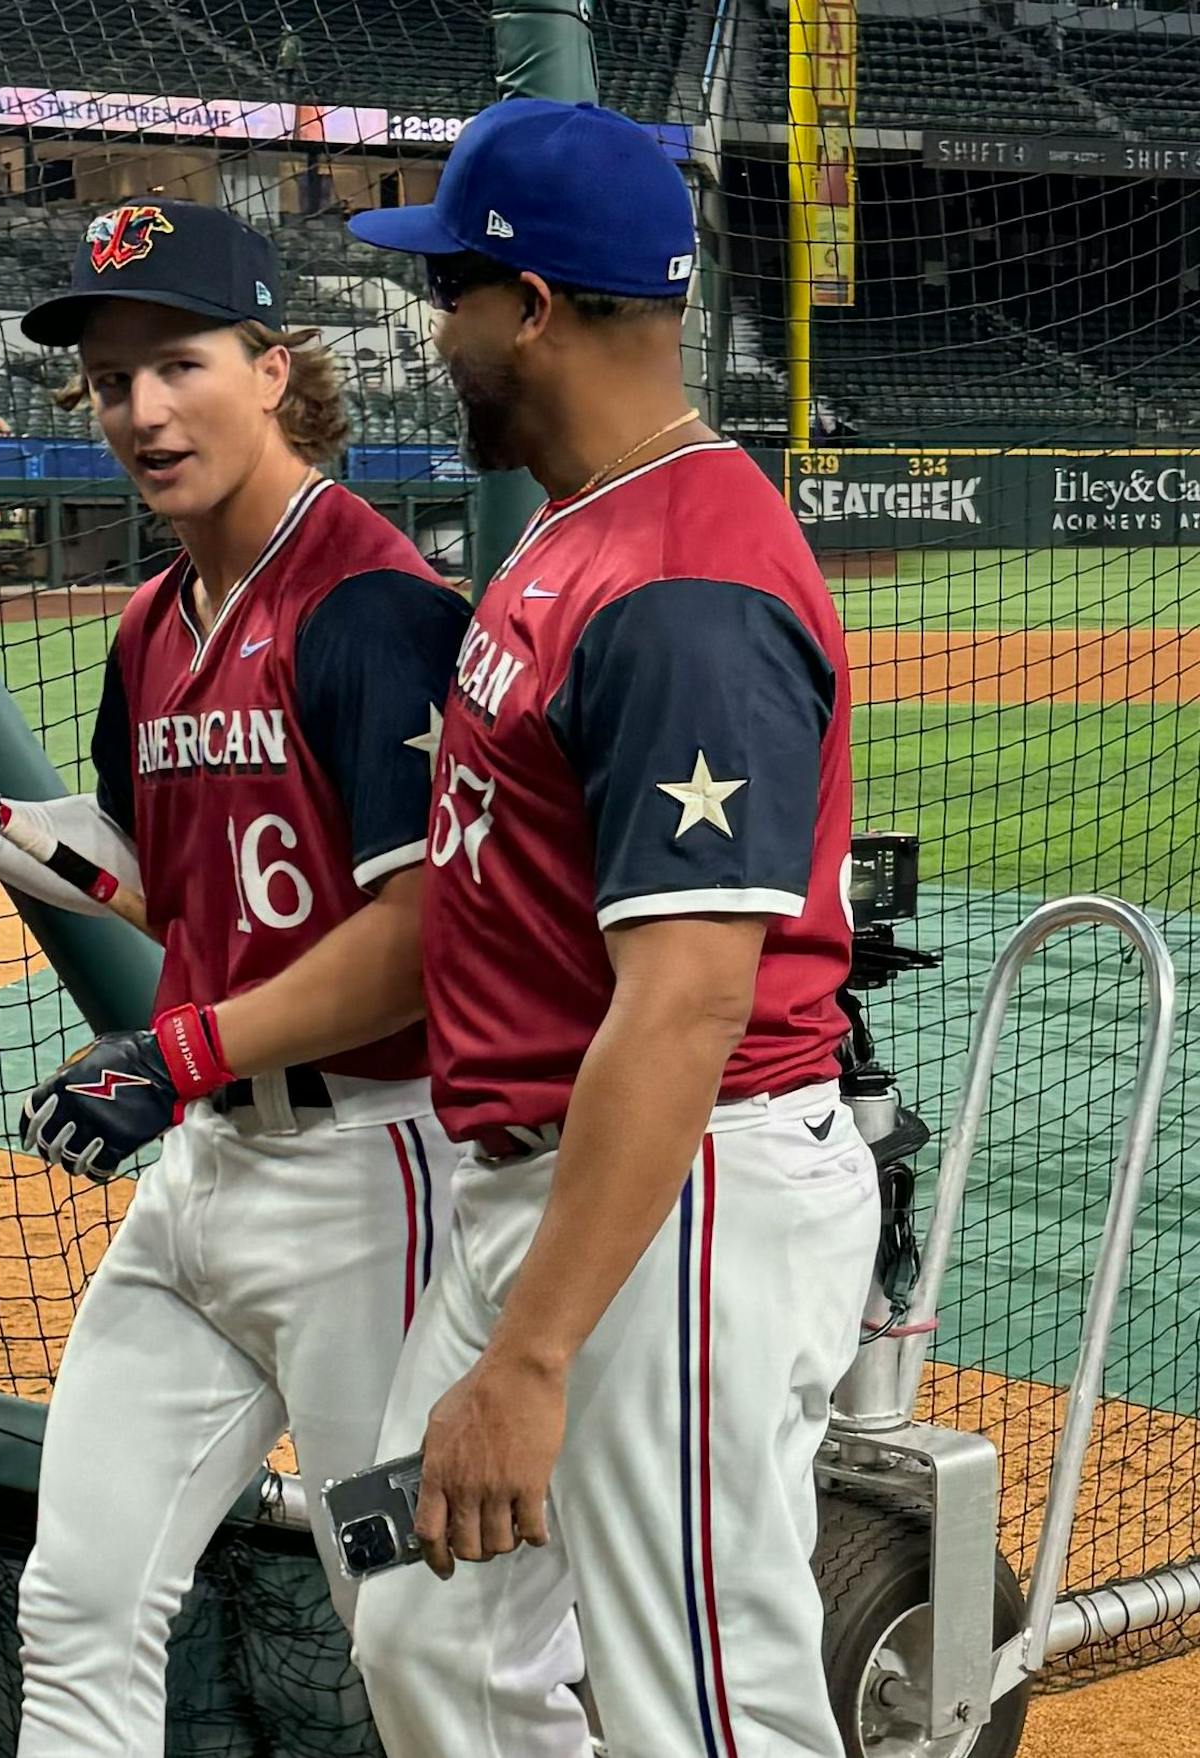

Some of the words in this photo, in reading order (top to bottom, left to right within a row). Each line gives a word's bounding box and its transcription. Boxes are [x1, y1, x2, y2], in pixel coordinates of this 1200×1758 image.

[177, 106, 231, 127] GAME
[799, 455, 839, 475] 329
[908, 457, 948, 477] 334
[798, 476, 982, 524] SEATGEEK
[138, 709, 288, 775] AMERICAN
[227, 813, 313, 933] 16
